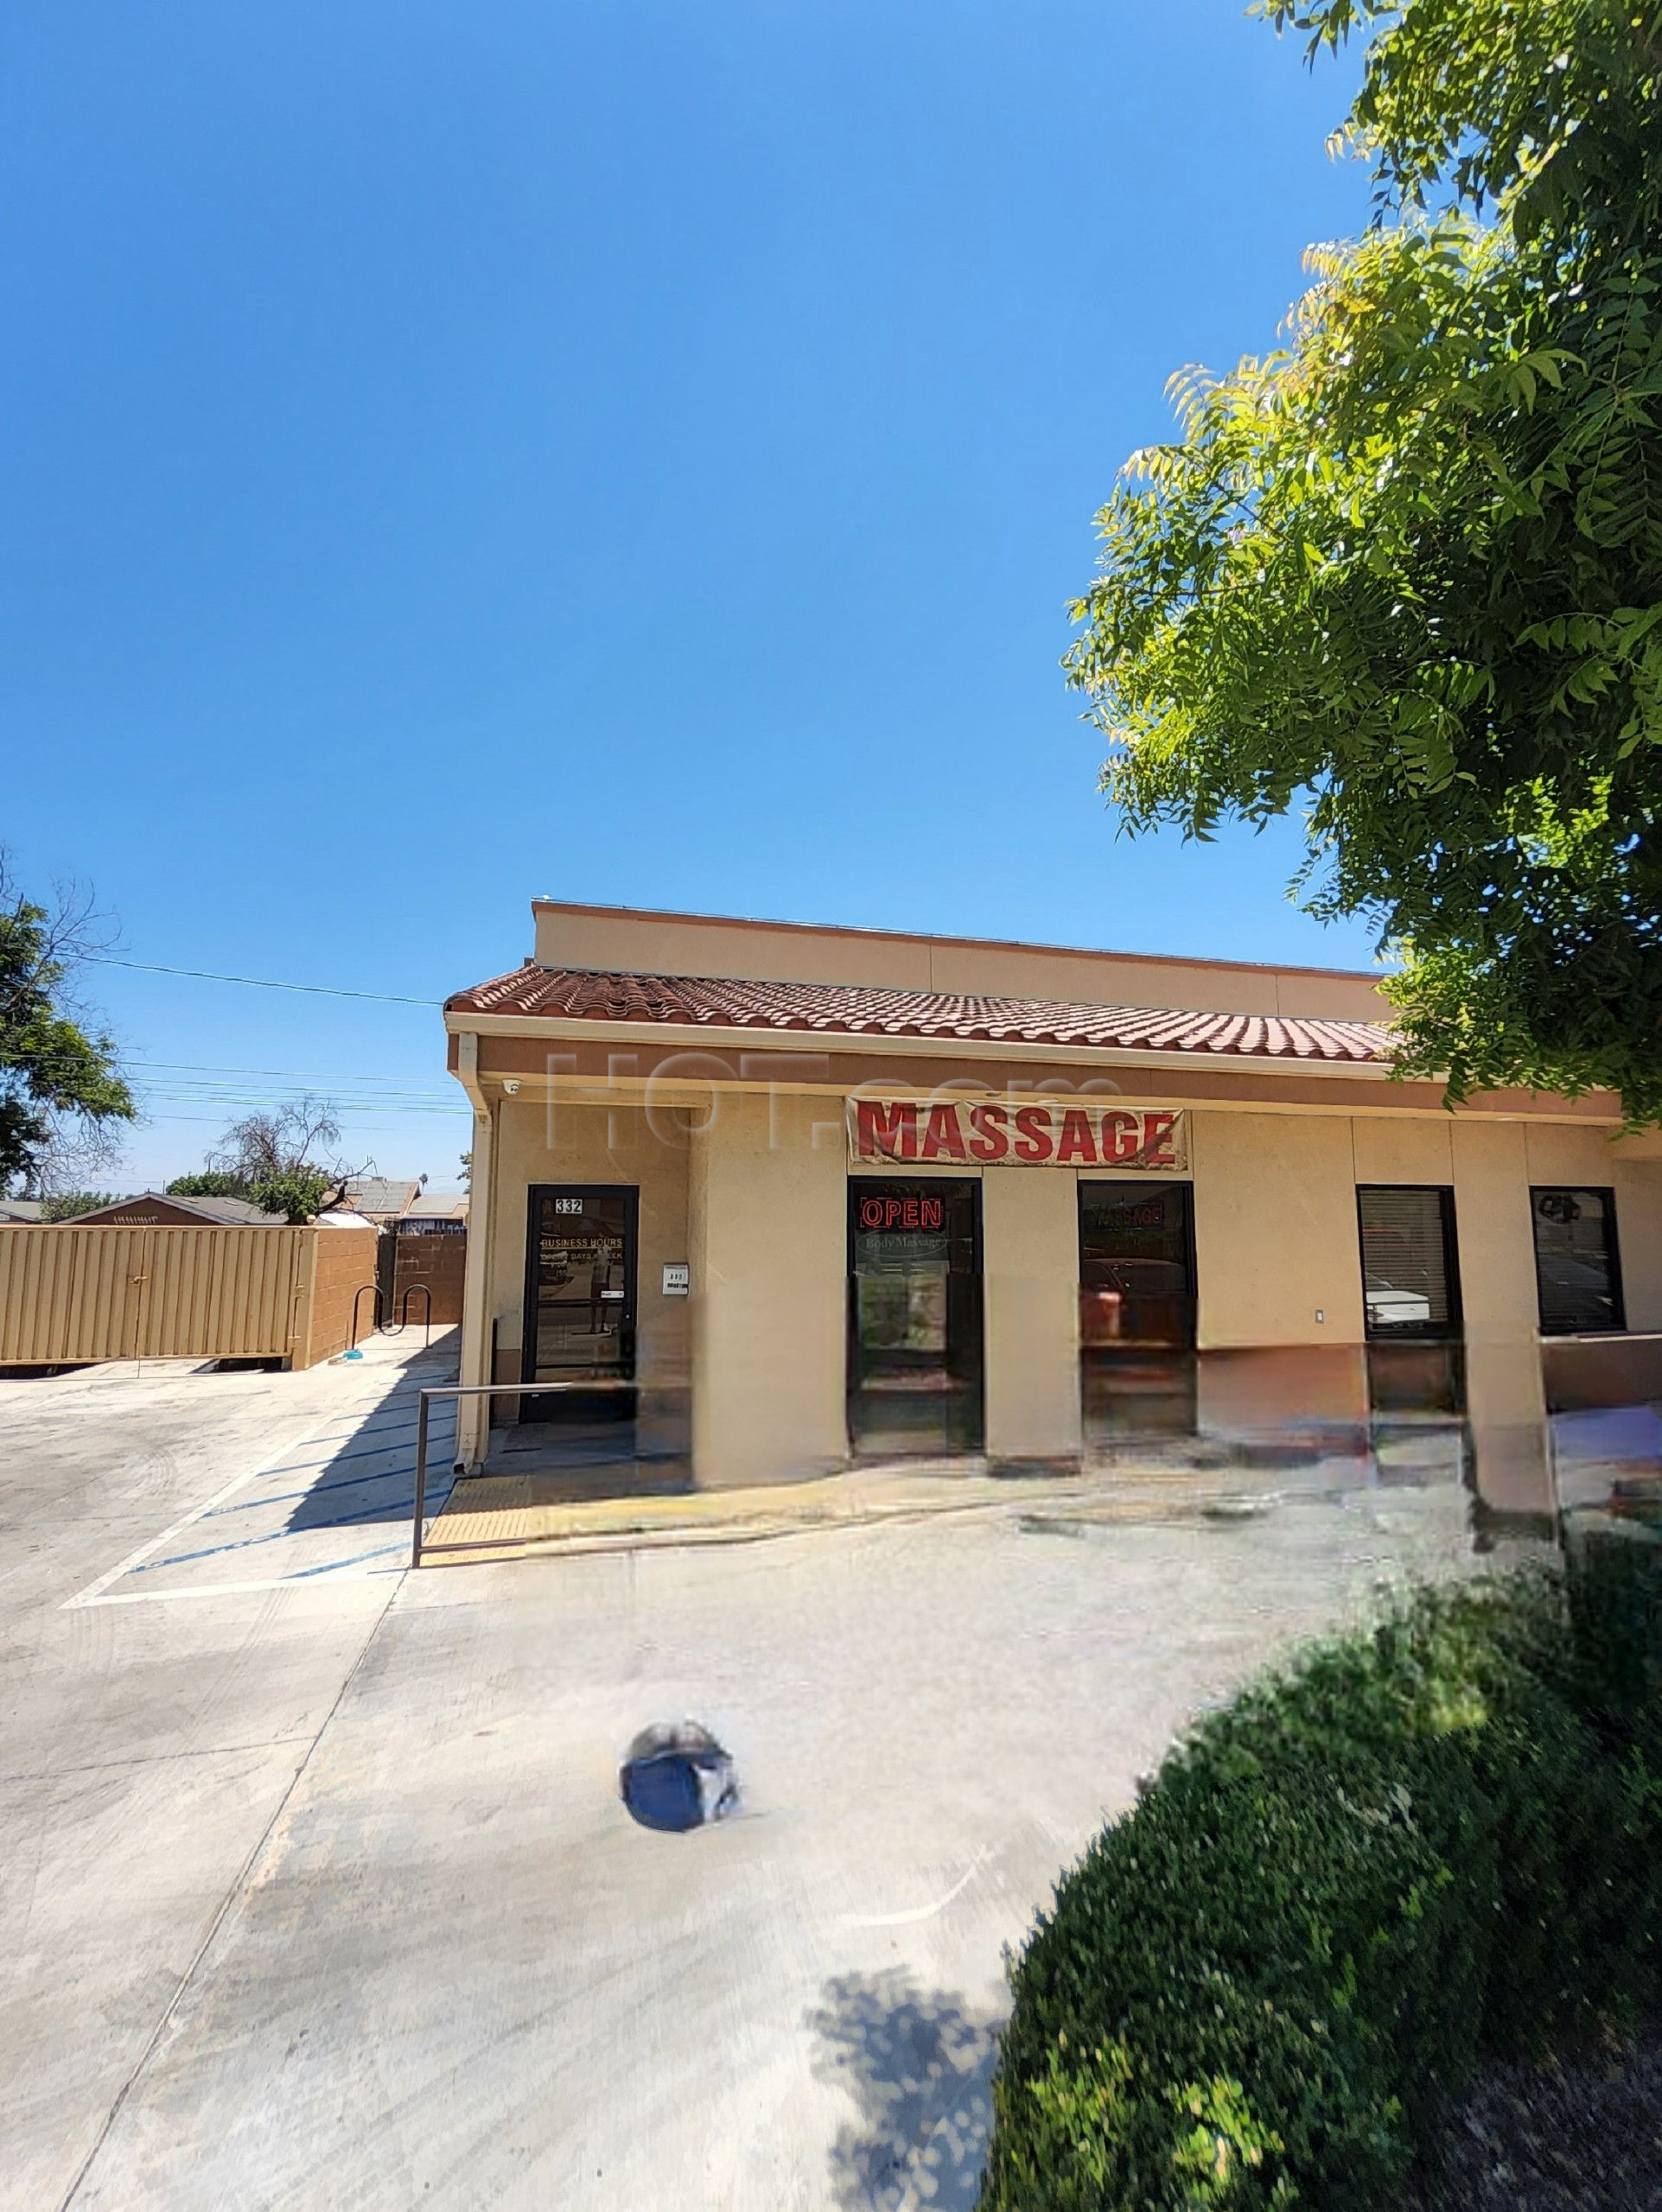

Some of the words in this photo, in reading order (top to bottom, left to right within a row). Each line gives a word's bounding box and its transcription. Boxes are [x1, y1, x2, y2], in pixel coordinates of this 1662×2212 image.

[858, 1101, 1176, 1164] MASSAGE
[557, 1199, 582, 1212] 332
[863, 1200, 940, 1225] OPEN
[543, 1238, 588, 1248] BUSINESS
[590, 1238, 622, 1247] HOURS
[866, 1236, 894, 1249] Body
[898, 1236, 941, 1249] Massage
